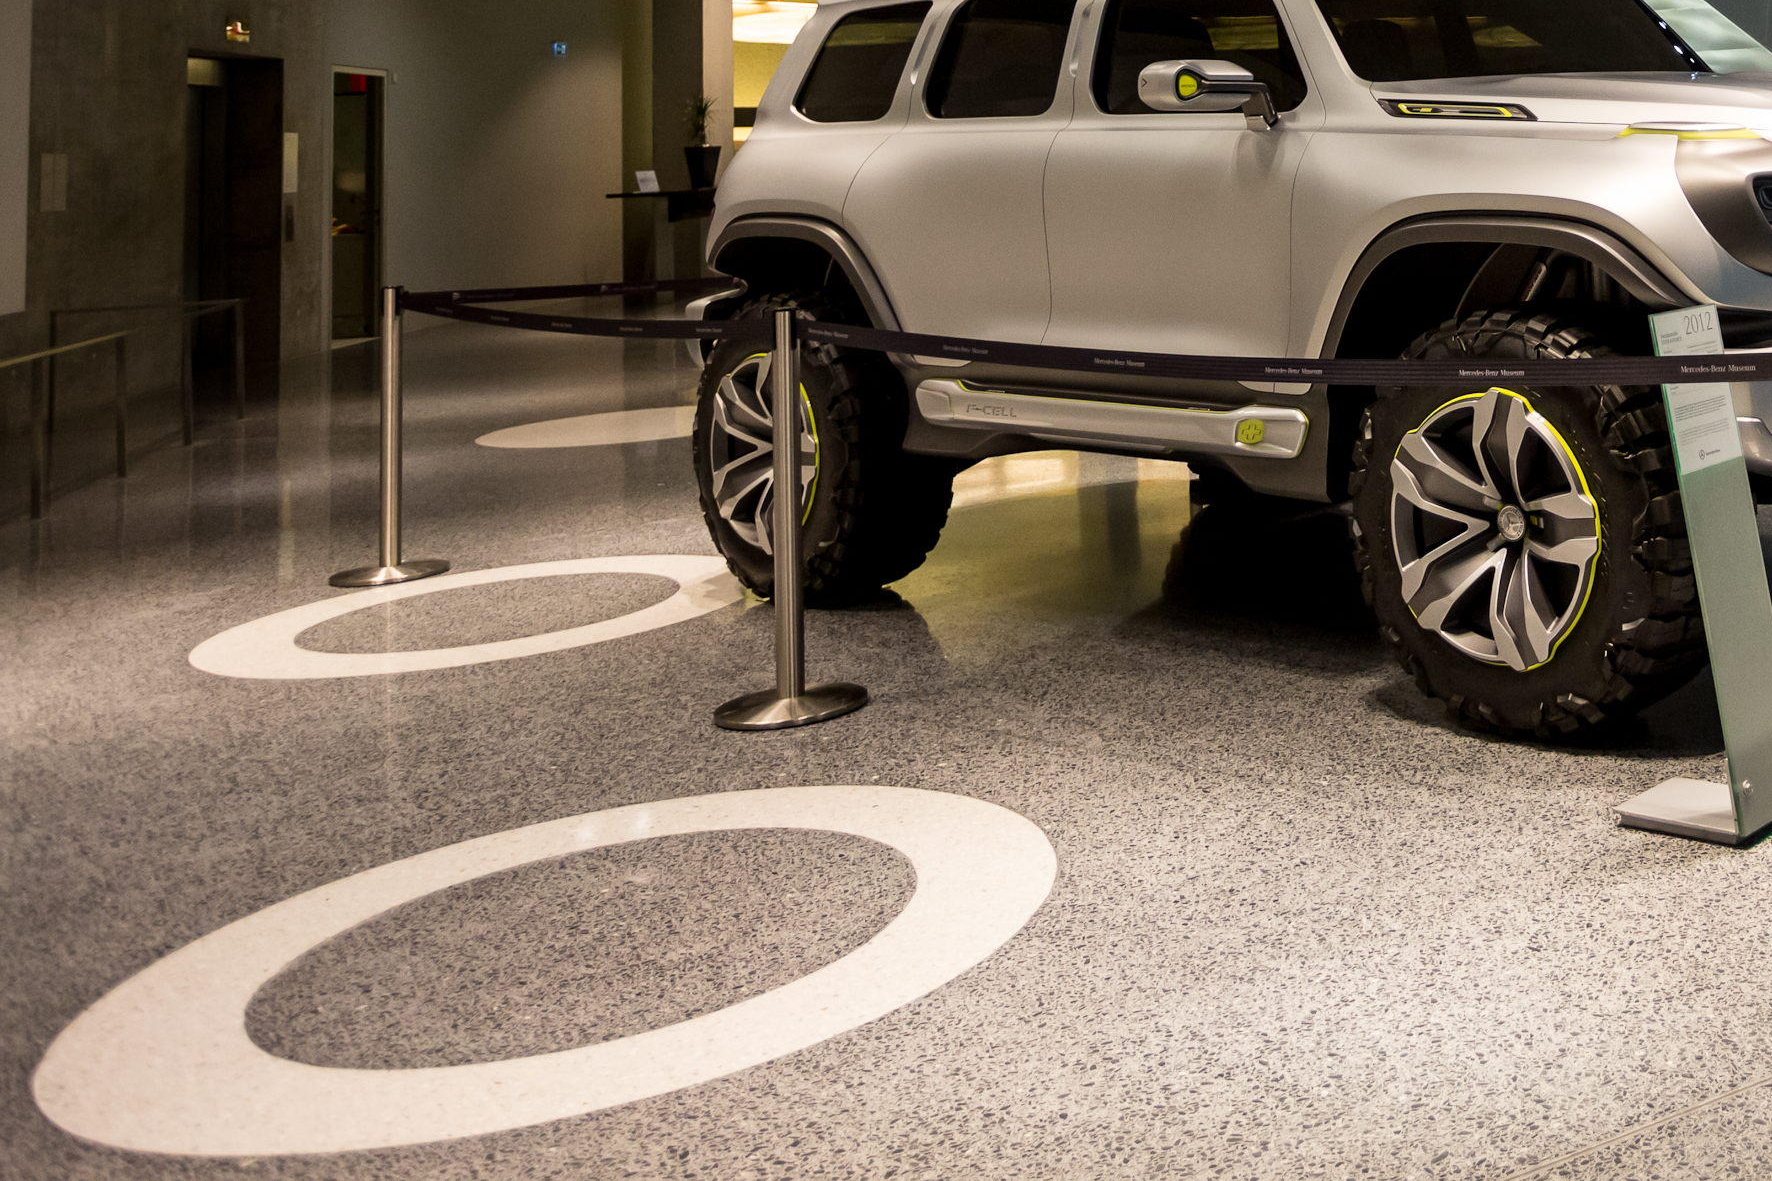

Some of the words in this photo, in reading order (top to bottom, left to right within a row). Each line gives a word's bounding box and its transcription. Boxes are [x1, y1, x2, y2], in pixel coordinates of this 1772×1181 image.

[1683, 311, 1713, 335] 2012
[1301, 367, 1323, 375] Museum
[1458, 369, 1499, 377] Mercedes-Benz
[1500, 369, 1525, 377] Museum
[1680, 364, 1727, 374] Mercedes-Benz
[1728, 364, 1756, 373] Museum
[966, 403, 1017, 418] F-CELL
